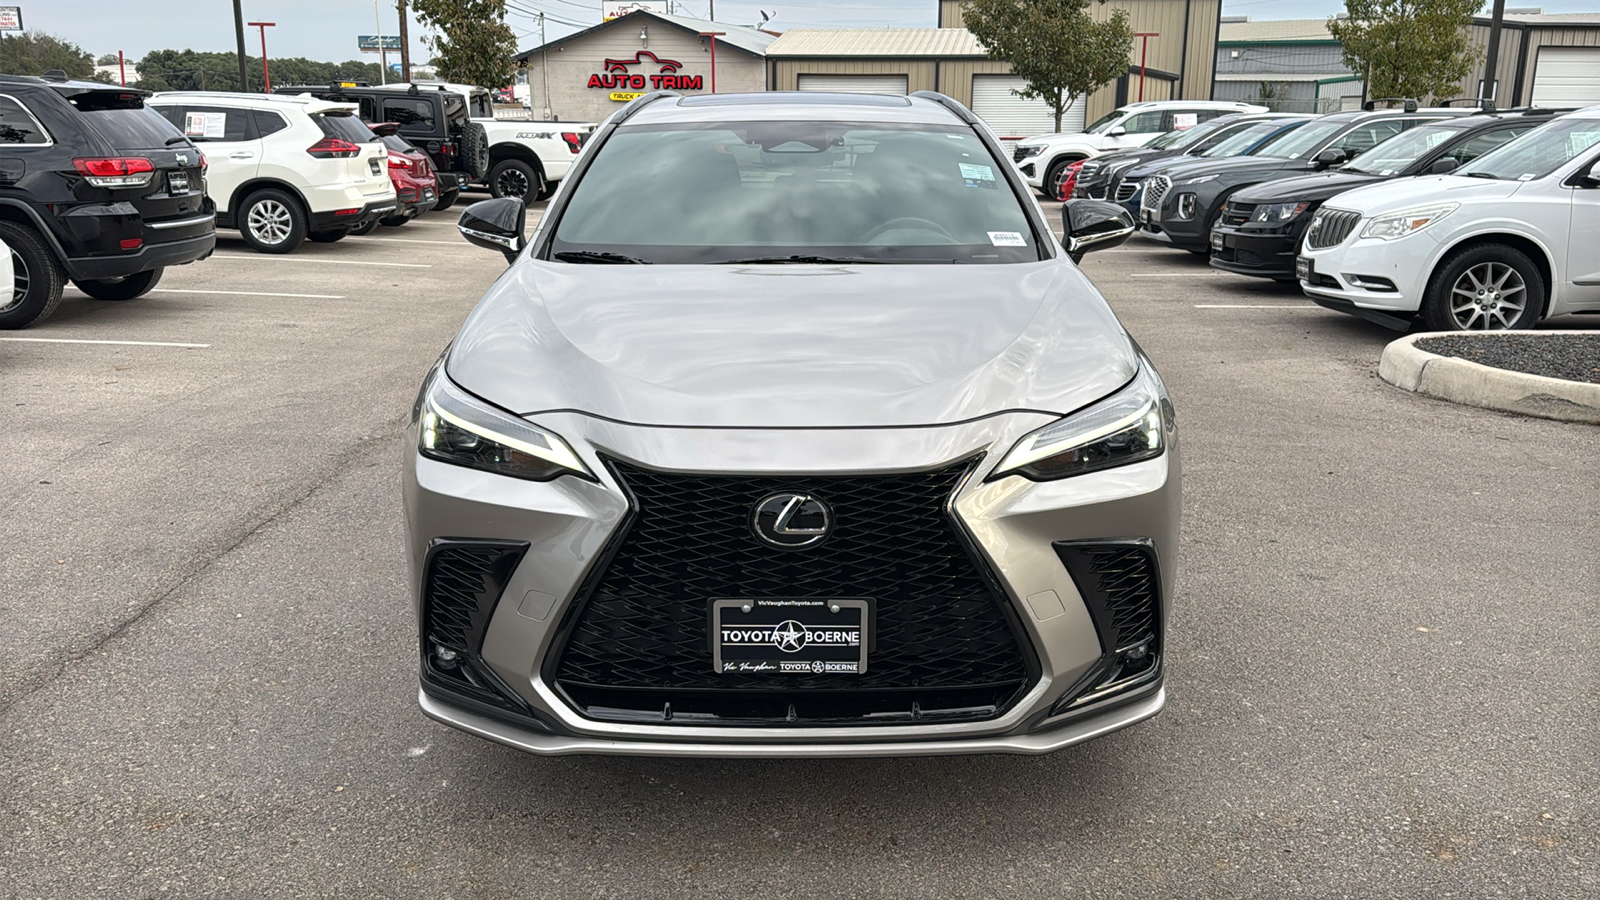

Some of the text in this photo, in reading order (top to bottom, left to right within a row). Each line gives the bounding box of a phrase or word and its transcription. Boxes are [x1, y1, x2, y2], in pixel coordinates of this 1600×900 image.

[588, 74, 703, 89] AUTO TRIM
[722, 630, 780, 642] TOYOTA
[806, 631, 859, 642] BOERNE
[723, 662, 738, 671] Vic
[739, 662, 777, 672] Vaughan
